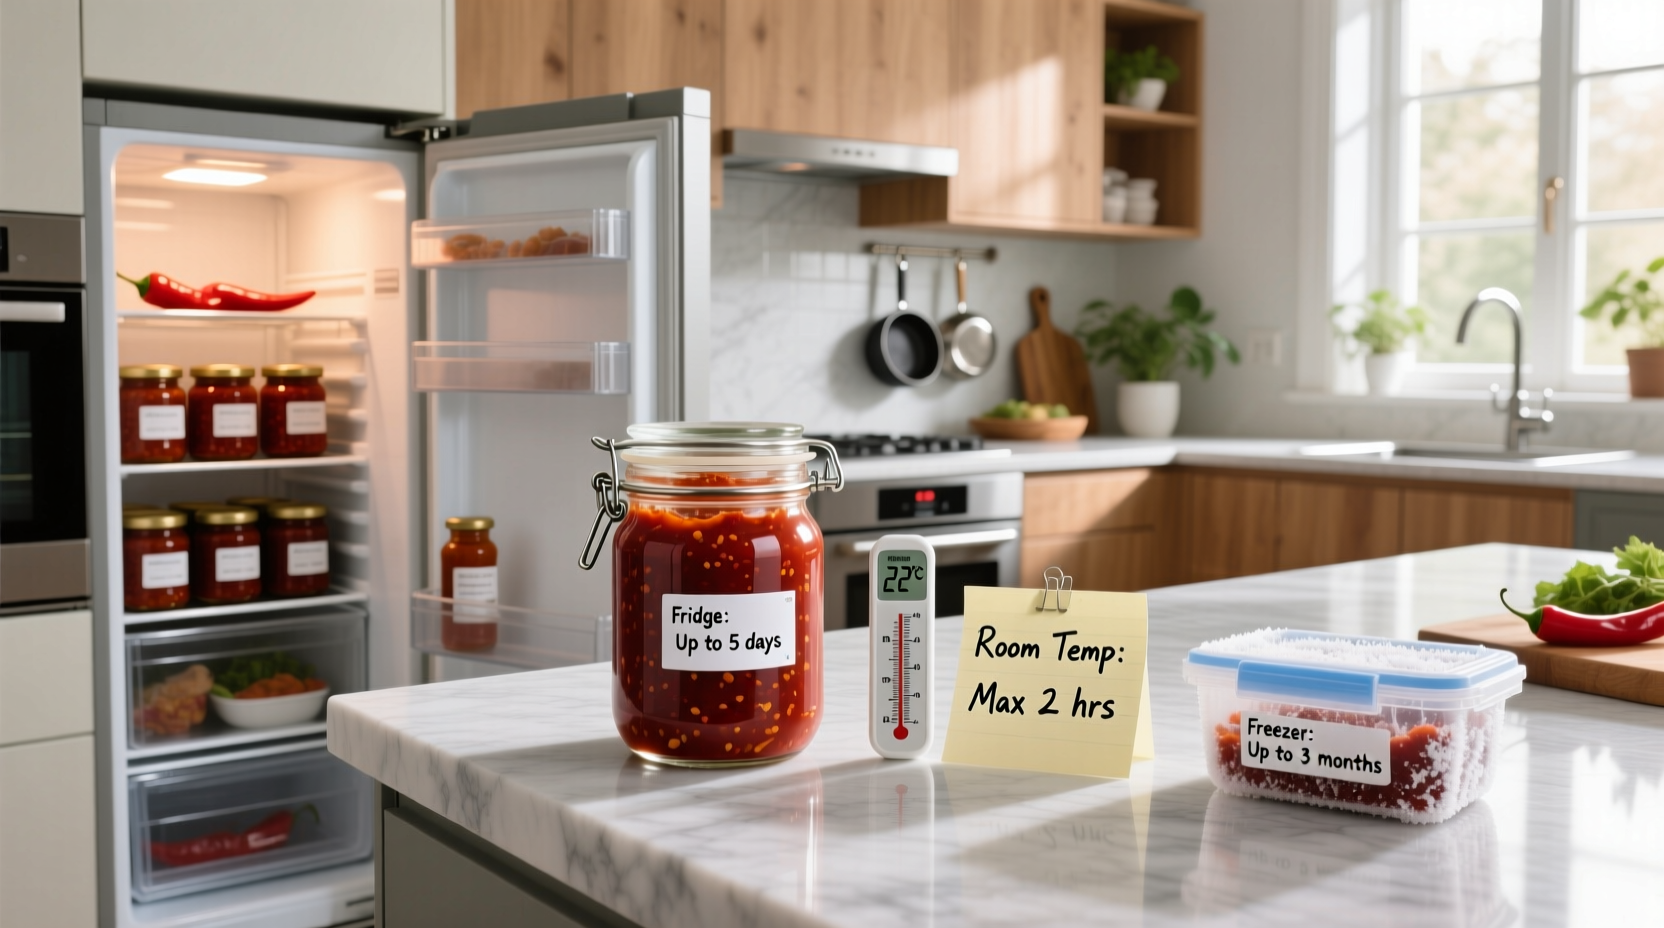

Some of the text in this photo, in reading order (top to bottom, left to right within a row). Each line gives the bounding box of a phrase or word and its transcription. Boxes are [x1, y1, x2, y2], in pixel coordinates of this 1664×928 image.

[672, 605, 729, 629] Fridge:
[676, 631, 782, 657] Up to 5 days
[974, 625, 1125, 675] Room Temp:
[967, 681, 1115, 720] Max 2 hrs
[1247, 717, 1314, 741] Freezer:
[1247, 740, 1382, 774] Up to 3 months
